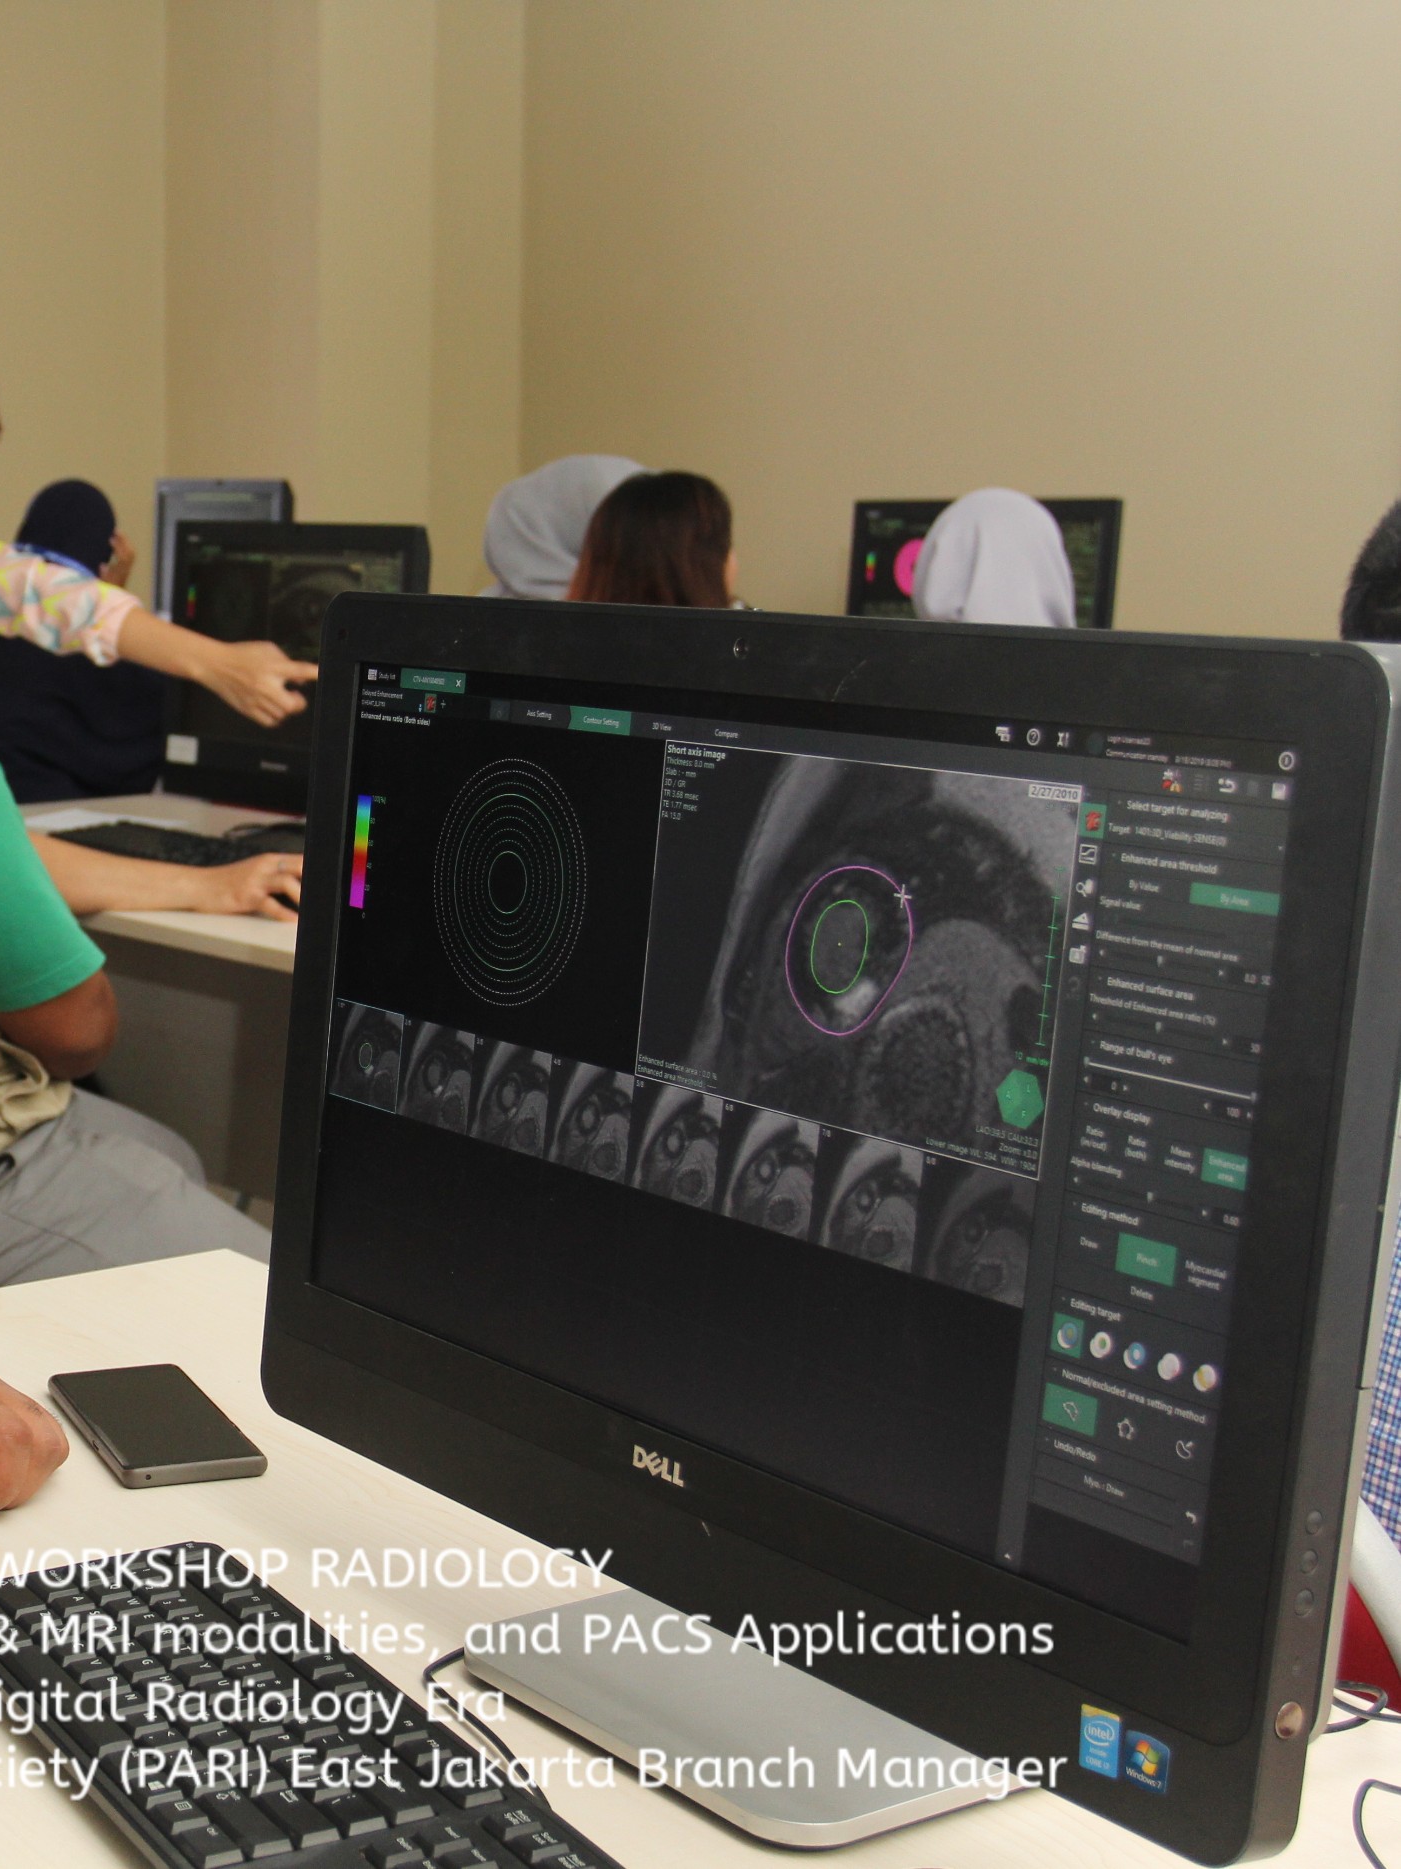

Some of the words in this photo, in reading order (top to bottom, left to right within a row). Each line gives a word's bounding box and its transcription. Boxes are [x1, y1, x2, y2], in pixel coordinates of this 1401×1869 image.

[361, 711, 382, 721] Enhanced
[382, 714, 391, 722] area
[392, 715, 403, 723] ratio
[417, 717, 430, 726] sides)
[583, 715, 602, 725] Contour
[603, 717, 620, 728] Setting
[714, 728, 739, 739] Compare
[667, 744, 687, 755] Short
[687, 747, 702, 757] axis
[703, 748, 726, 761] image
[664, 778, 672, 786] 3D
[677, 779, 686, 788] GR
[663, 789, 671, 797] TR
[684, 793, 699, 801] msec
[1031, 786, 1078, 800] 2/27/2010
[662, 800, 669, 808] TE
[1127, 800, 1150, 811] Select
[1151, 804, 1175, 816] target
[1176, 805, 1189, 815] for
[1190, 808, 1230, 824] analyzing
[1120, 852, 1158, 867] Enhanced
[1178, 862, 1218, 875] threshold
[1107, 976, 1146, 992] Enhanced
[1146, 984, 1174, 997] surface
[1174, 990, 1195, 1001] area
[1100, 1040, 1124, 1055] Range
[637, 1065, 663, 1078] Enhanced
[638, 1054, 665, 1067] Enhanced
[665, 1061, 685, 1073] surface
[1092, 1102, 1122, 1118] Overlay
[1123, 1110, 1152, 1126] display
[1081, 1202, 1107, 1220] Editing
[1108, 1210, 1140, 1227] method
[1184, 1259, 1227, 1279] Myocardial
[1070, 1297, 1096, 1317] Editing
[1097, 1305, 1122, 1321] target
[1062, 1368, 1126, 1397] Normal/excluded
[1127, 1392, 1145, 1404] area
[1147, 1396, 1173, 1416] setting
[1174, 1406, 1207, 1424] method
[1053, 1439, 1097, 1462] Undo/Redo
[632, 1444, 684, 1488] DELL
[1087, 1724, 1111, 1741] intel
[1125, 1766, 1156, 1788] Windows
